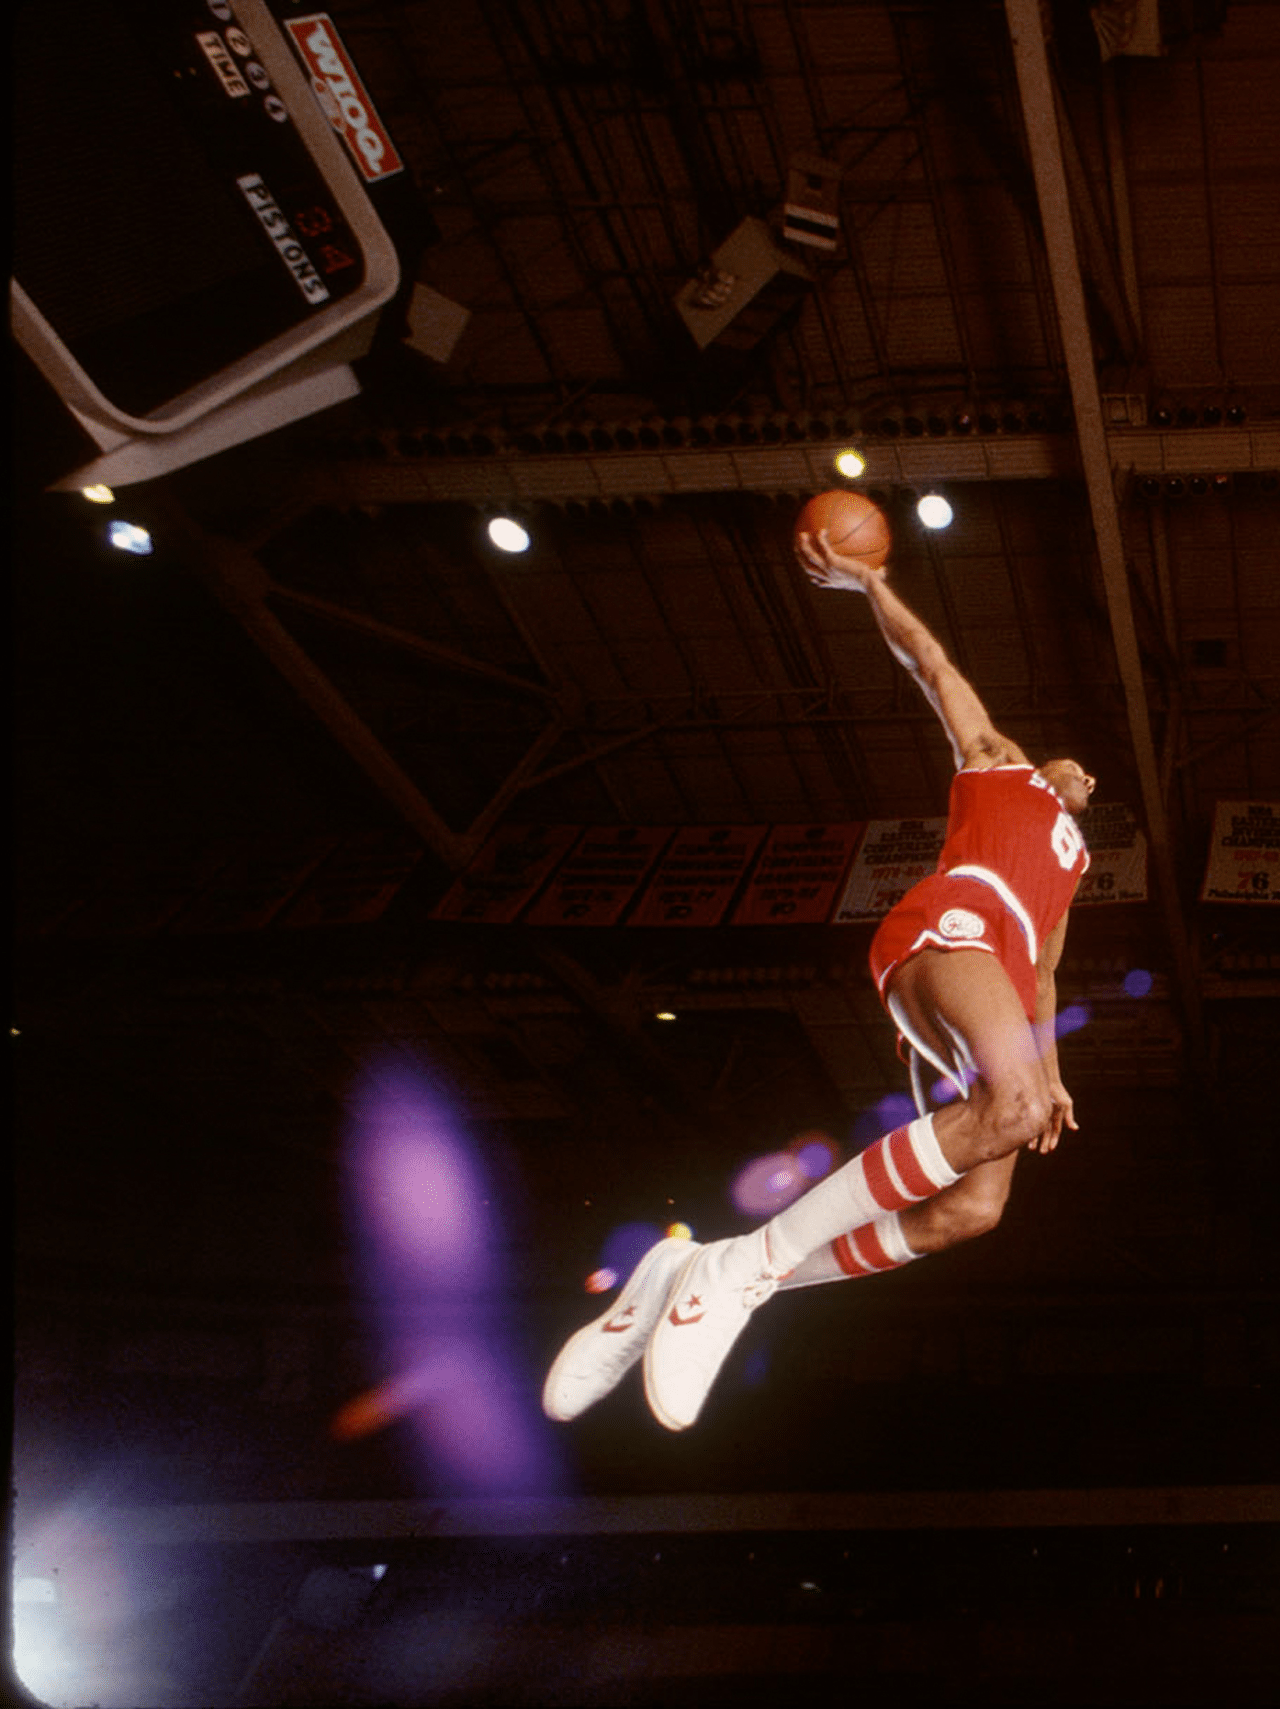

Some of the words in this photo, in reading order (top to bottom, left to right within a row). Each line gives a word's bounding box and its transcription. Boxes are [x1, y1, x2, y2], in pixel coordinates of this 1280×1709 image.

[203, 35, 246, 93] TIME
[306, 21, 385, 174] WIOQ
[246, 184, 326, 295] PISTONS
[295, 206, 355, 275] 34
[1051, 811, 1085, 872] 6
[1237, 870, 1270, 890] 76
